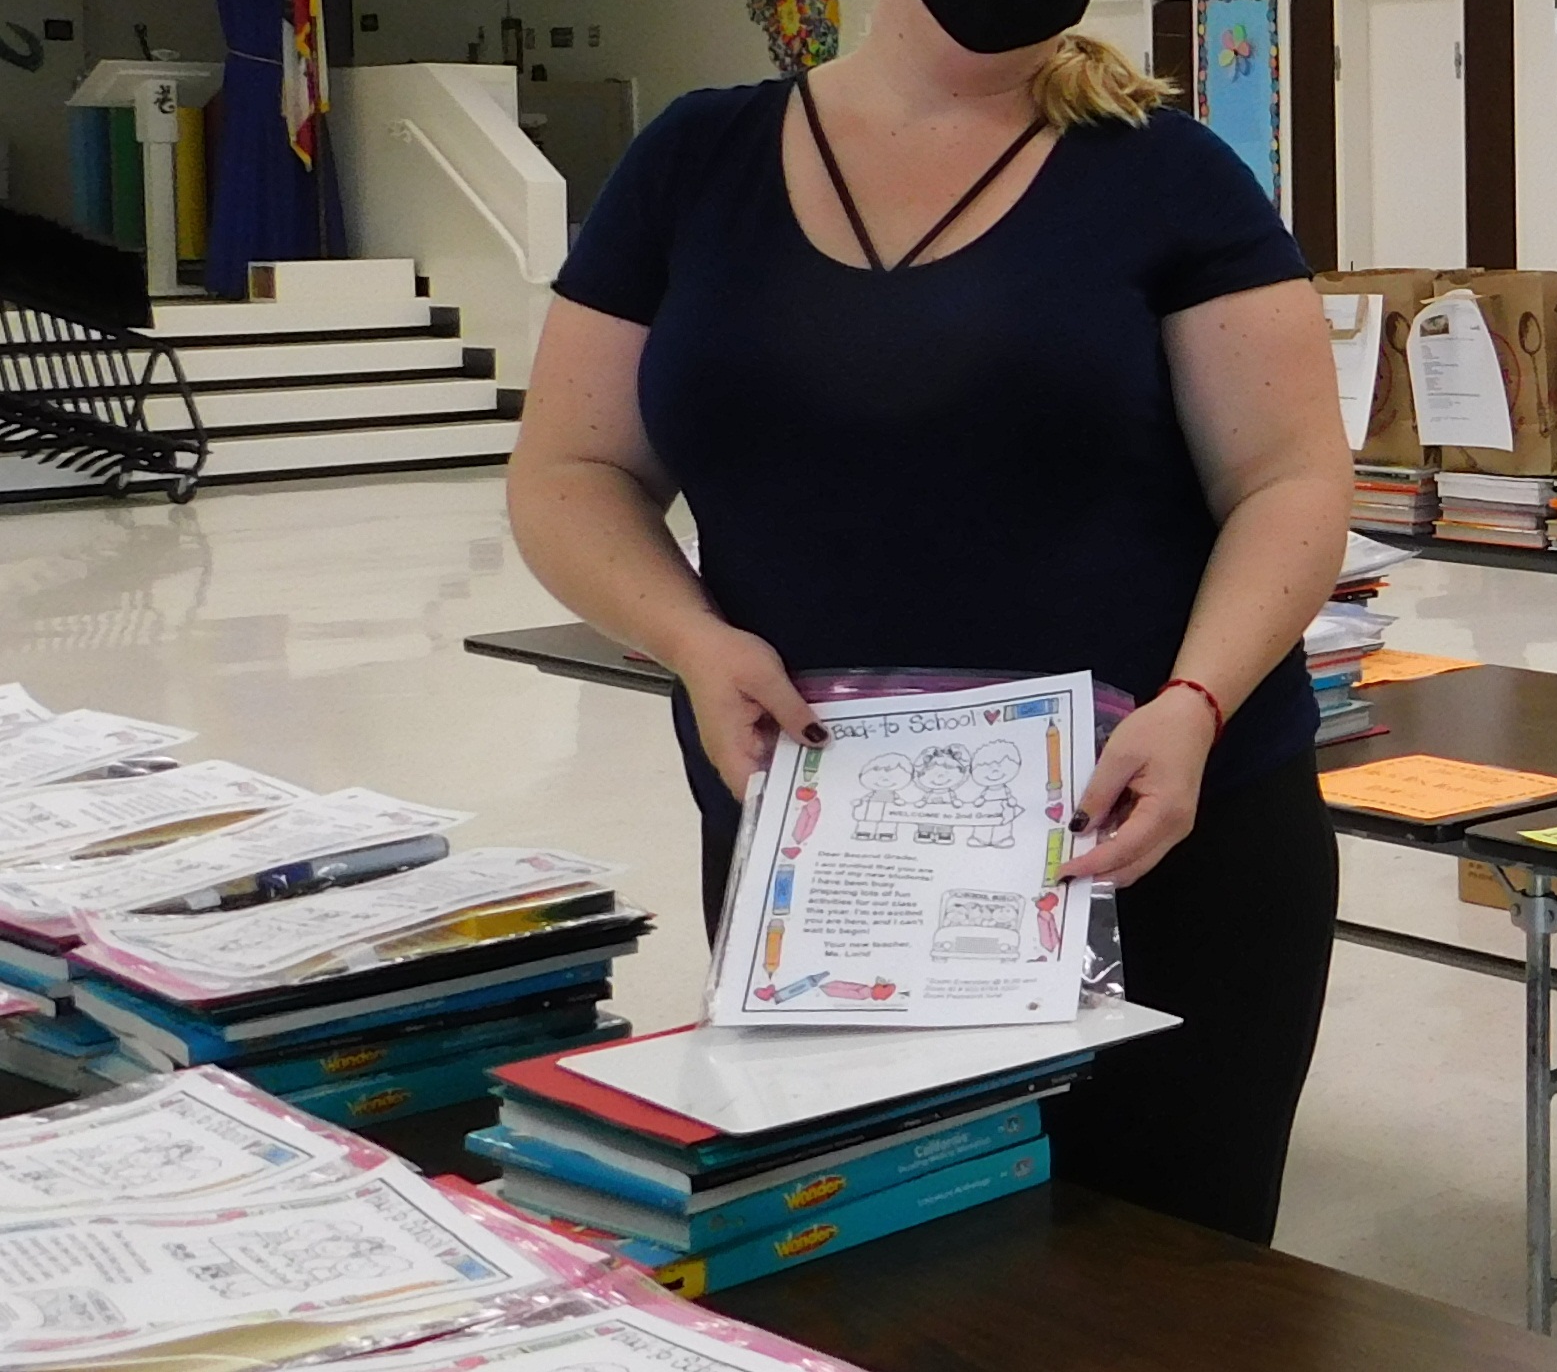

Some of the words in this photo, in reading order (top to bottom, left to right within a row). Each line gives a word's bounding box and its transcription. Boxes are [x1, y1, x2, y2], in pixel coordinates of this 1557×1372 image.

[832, 720, 876, 741] Back
[883, 715, 900, 738] to
[909, 710, 975, 734] School
